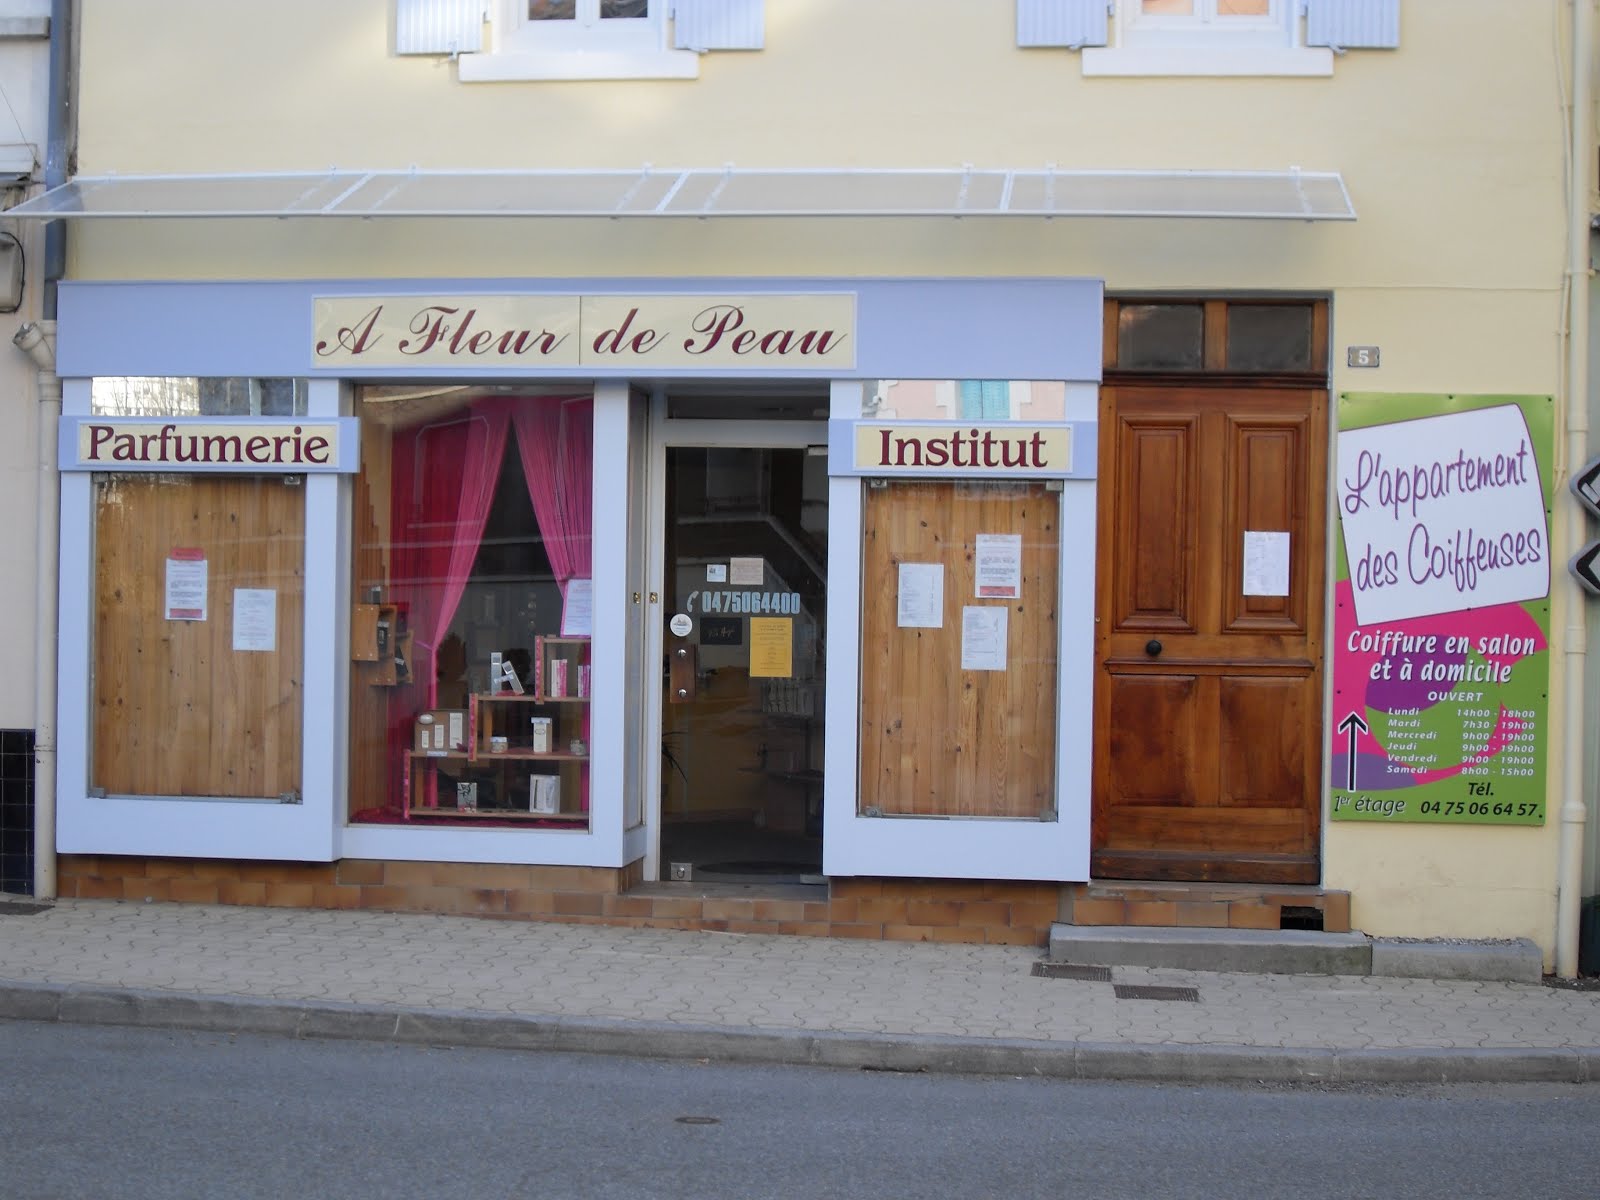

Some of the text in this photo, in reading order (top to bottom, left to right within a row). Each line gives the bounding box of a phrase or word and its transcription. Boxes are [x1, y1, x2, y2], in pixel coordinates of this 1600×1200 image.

[316, 305, 848, 357] A Fleur de Peau
[1358, 350, 1369, 364] 5
[88, 425, 329, 463] Parfumerie
[879, 428, 1048, 467] Institut
[1344, 438, 1528, 520] L'appartement
[1356, 543, 1398, 591] des
[1407, 523, 1541, 593] Coiffeuses
[702, 591, 800, 614] 0475064400
[1347, 630, 1535, 656] Coiffure en salon
[1370, 658, 1512, 682] et à domicile
[1428, 691, 1483, 702] OUVERT
[1388, 707, 1419, 716] Lundi
[1457, 709, 1490, 717] 14h00
[1502, 710, 1535, 718] 18h00
[1388, 719, 1420, 727] Mardi
[1463, 720, 1490, 729] 7h30
[1501, 721, 1535, 730] 19h00
[1388, 730, 1437, 740] Mercredi
[1462, 732, 1489, 740] 9h00
[1501, 733, 1535, 742] 19h00
[1387, 742, 1417, 750] Jeudi
[1462, 743, 1489, 752] 9h00
[1501, 744, 1534, 753] 19h00
[1387, 753, 1437, 762] Vendredi
[1462, 755, 1489, 763] 9h00
[1501, 756, 1534, 765] 19h00
[1386, 765, 1427, 774] Samedi
[1461, 766, 1489, 775] 8h00
[1501, 767, 1534, 776] 15h00
[1468, 782, 1495, 796] Tél.
[1334, 795, 1405, 817] 1er étage
[1420, 801, 1538, 816] 04 75 06 64 57
